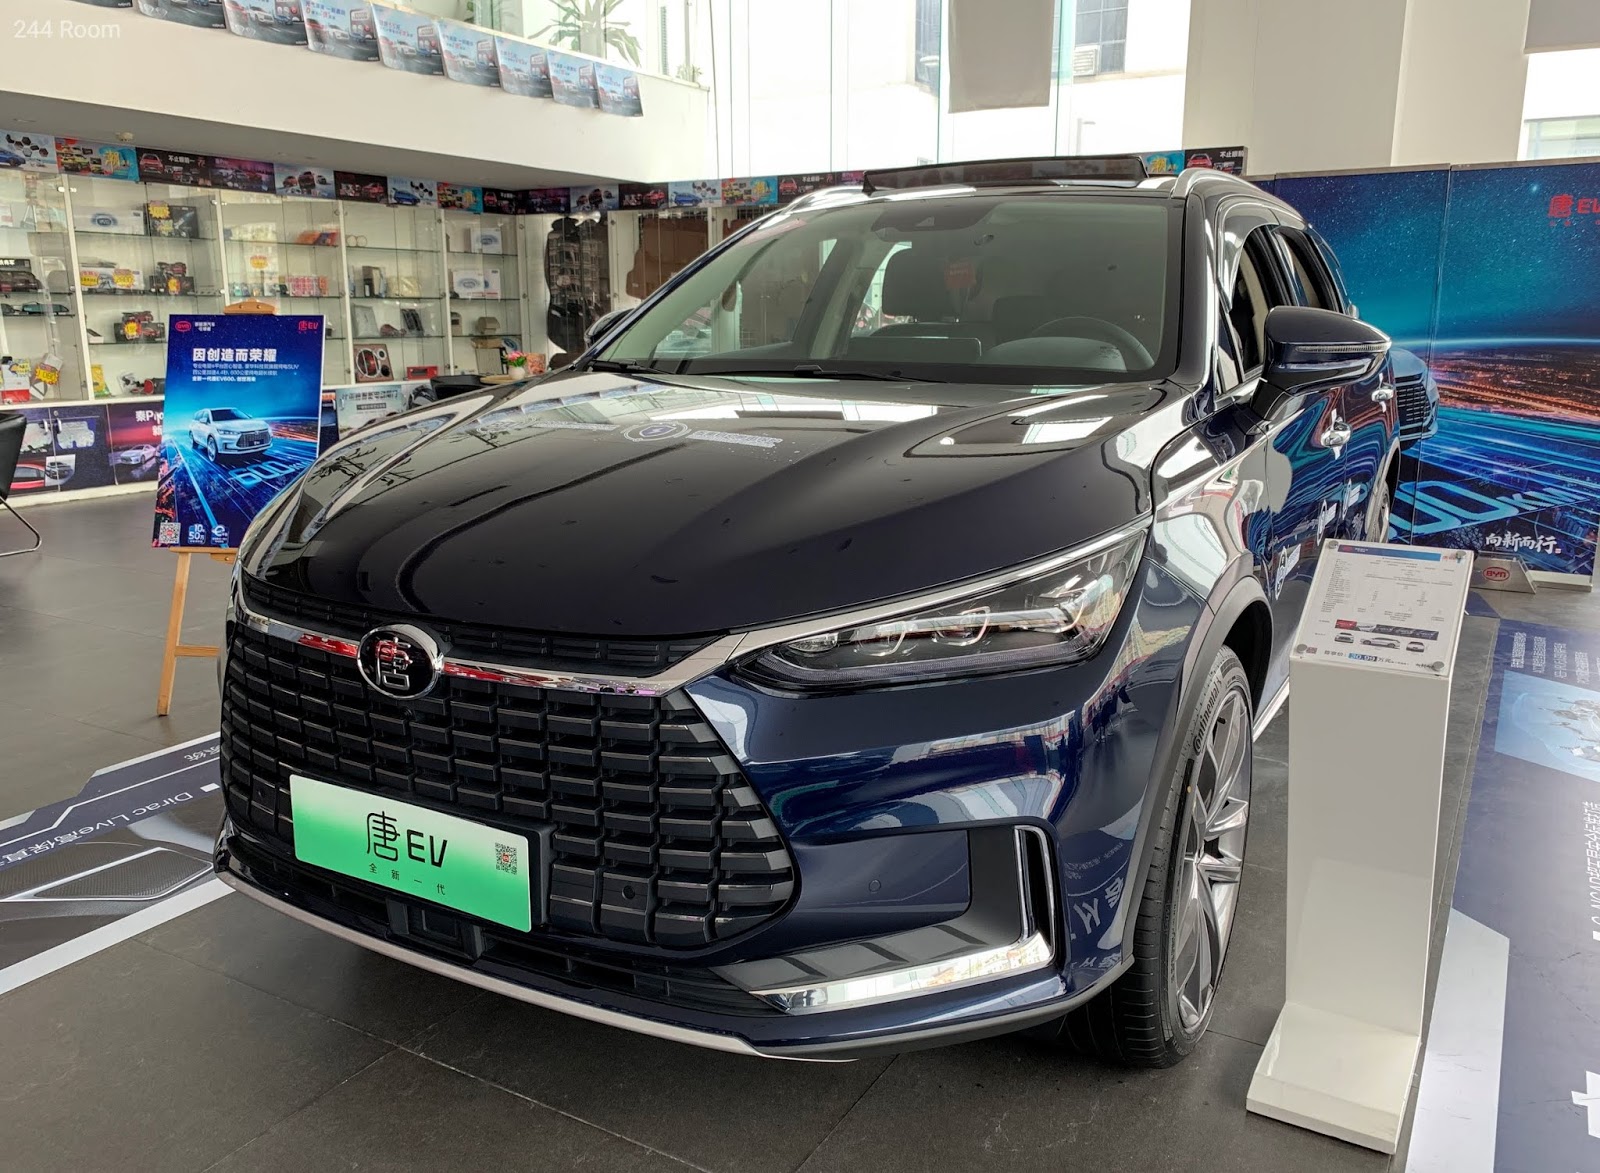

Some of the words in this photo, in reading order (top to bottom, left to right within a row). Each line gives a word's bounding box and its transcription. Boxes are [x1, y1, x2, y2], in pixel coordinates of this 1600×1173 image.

[192, 347, 278, 363] 因创造而荣耀
[1485, 530, 1558, 555] 向新而行
[131, 791, 194, 817] Dirac
